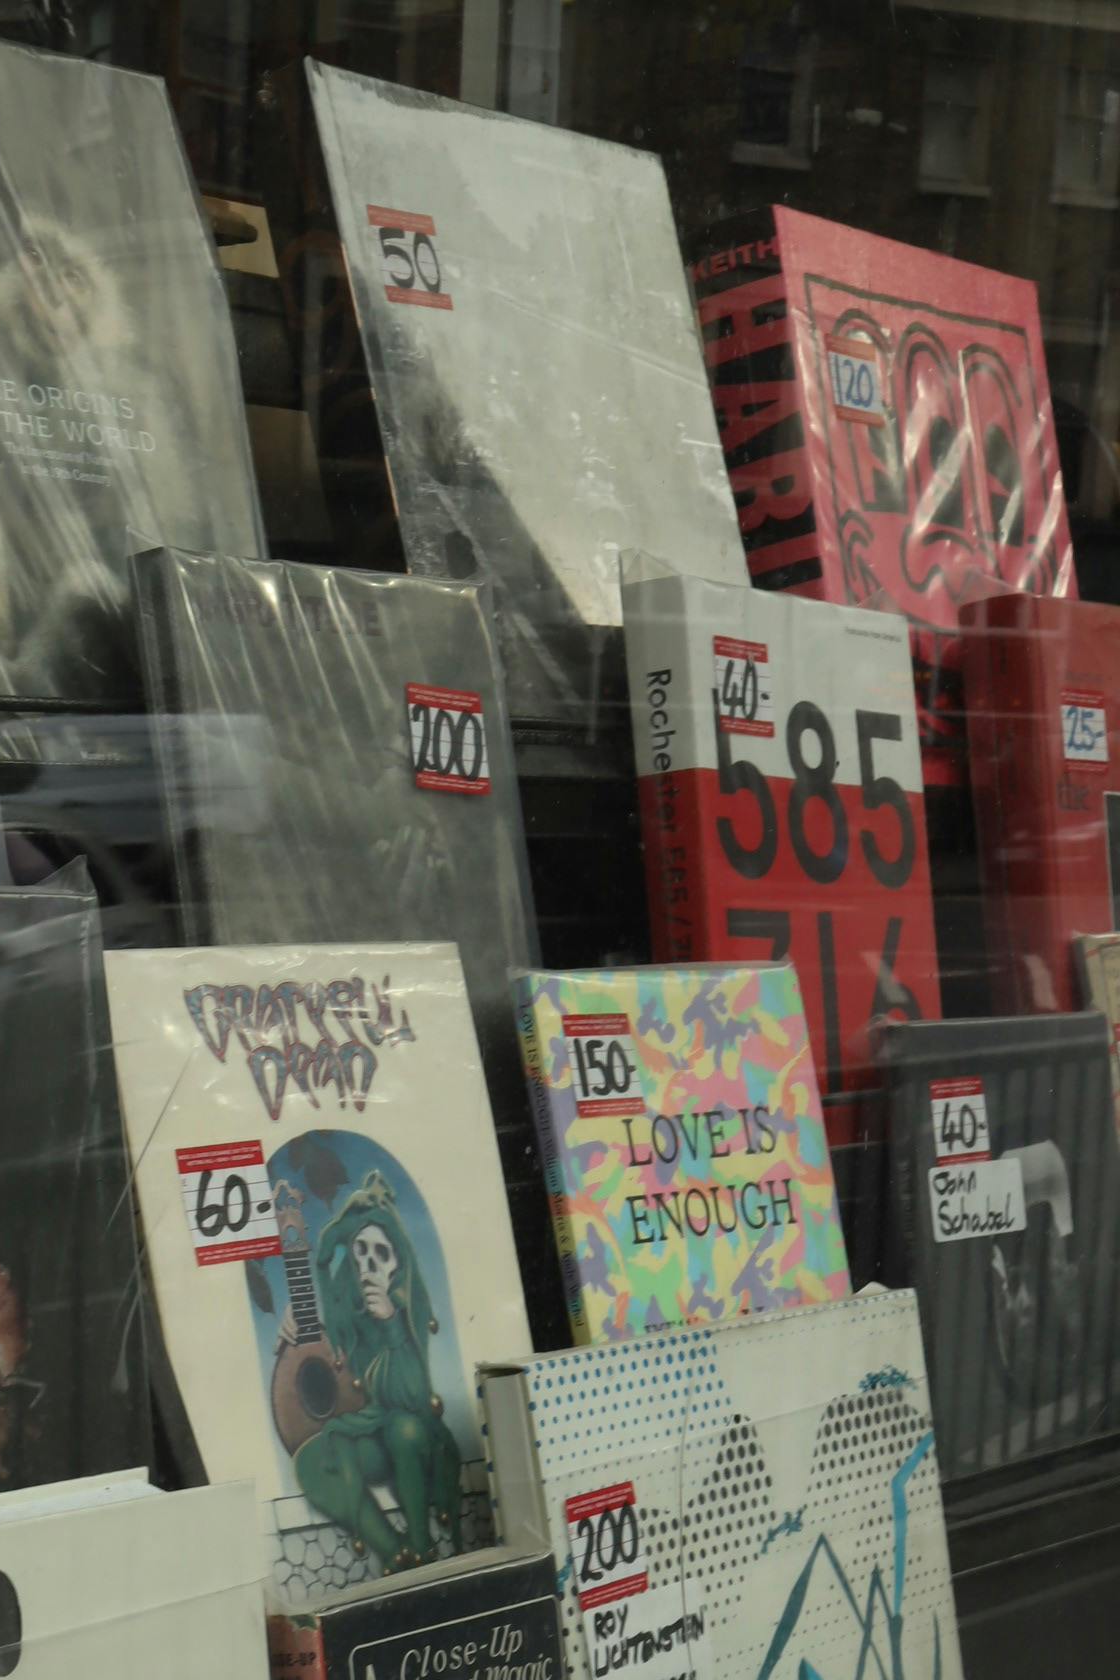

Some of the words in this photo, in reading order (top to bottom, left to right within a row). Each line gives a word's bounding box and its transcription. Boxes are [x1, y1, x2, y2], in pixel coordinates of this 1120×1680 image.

[379, 227, 441, 293] 50
[690, 236, 781, 283] KEITH
[28, 384, 135, 419] ORIGINS
[834, 354, 874, 408] 120
[61, 420, 156, 452] WORLD
[696, 270, 827, 601] HARI
[712, 688, 916, 889] 585
[622, 1110, 731, 1167] LOVE
[739, 1106, 778, 1156] IS
[626, 1178, 798, 1245] ENOUGH
[593, 1603, 628, 1641] ROY
